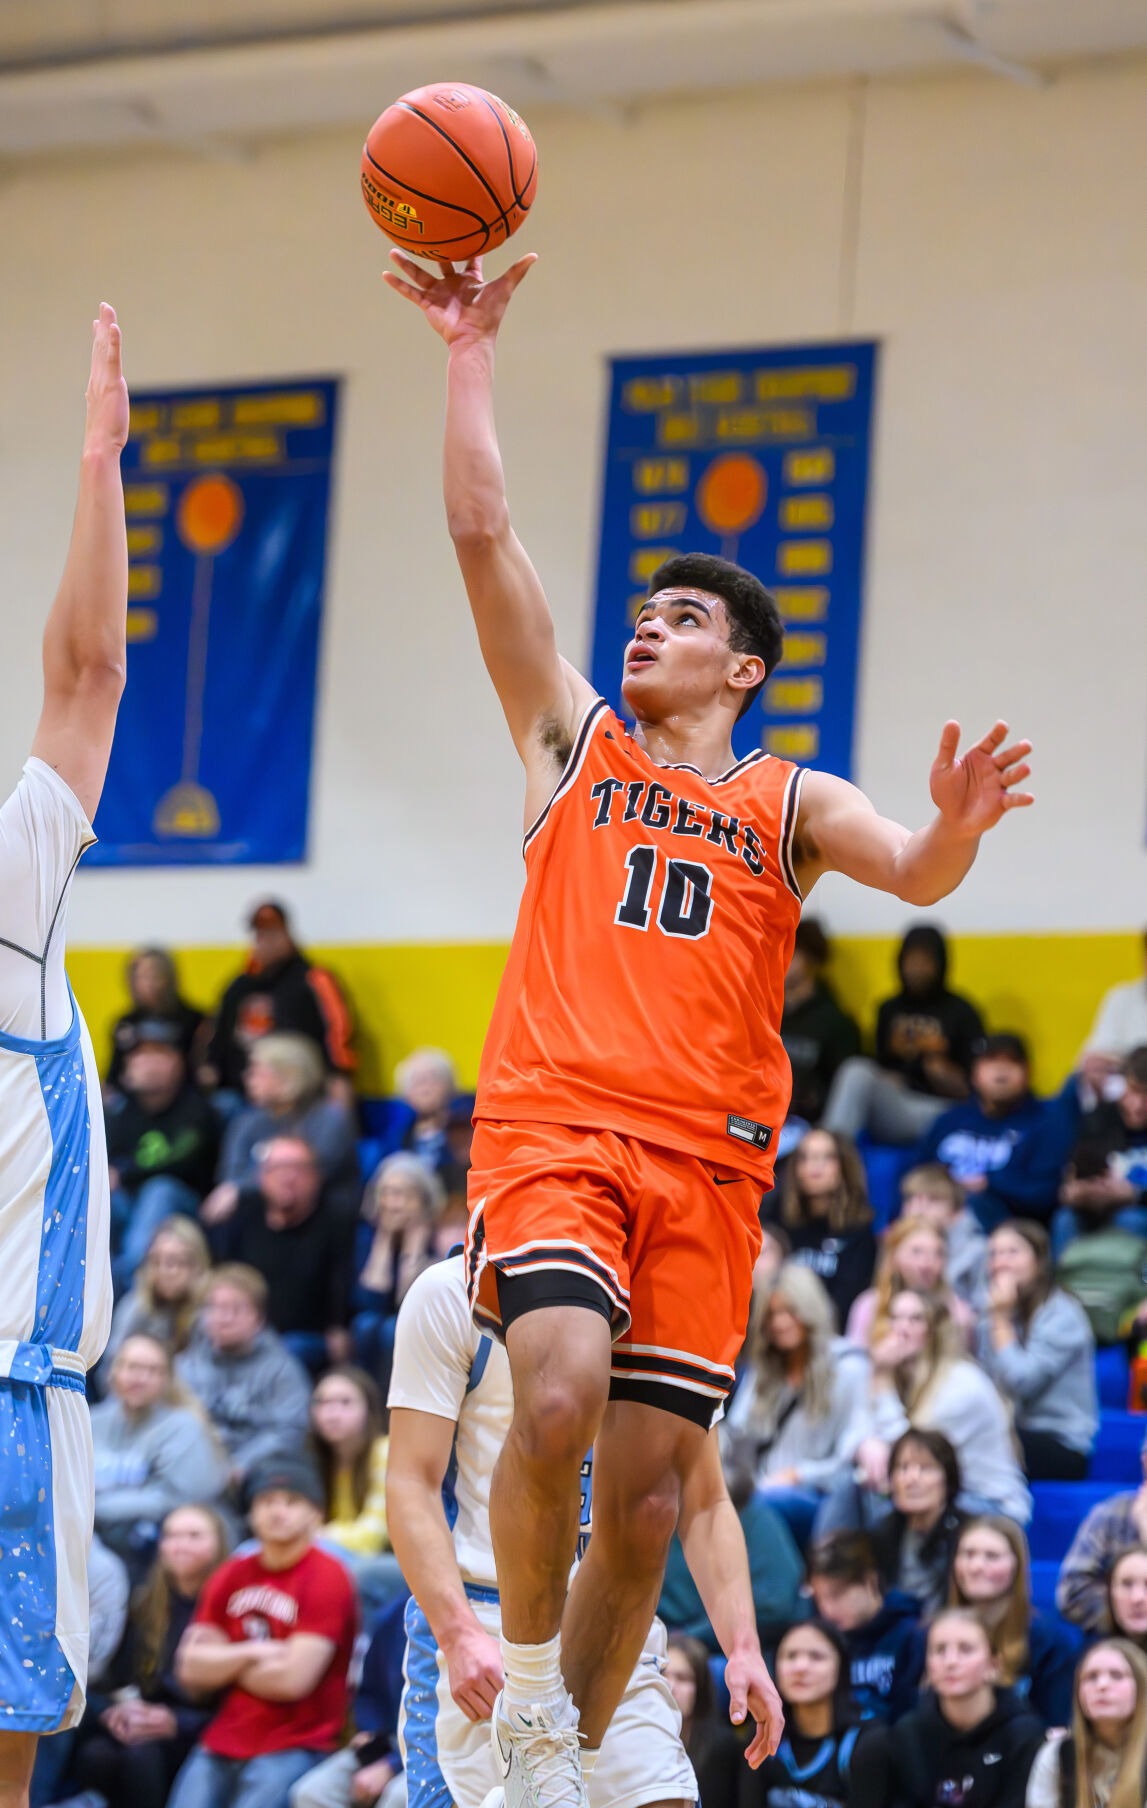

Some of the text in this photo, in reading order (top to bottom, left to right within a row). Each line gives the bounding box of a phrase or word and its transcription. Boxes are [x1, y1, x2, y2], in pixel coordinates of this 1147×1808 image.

[590, 777, 766, 876] TIGERS
[613, 844, 715, 940] 10
[758, 1131, 767, 1143] M
